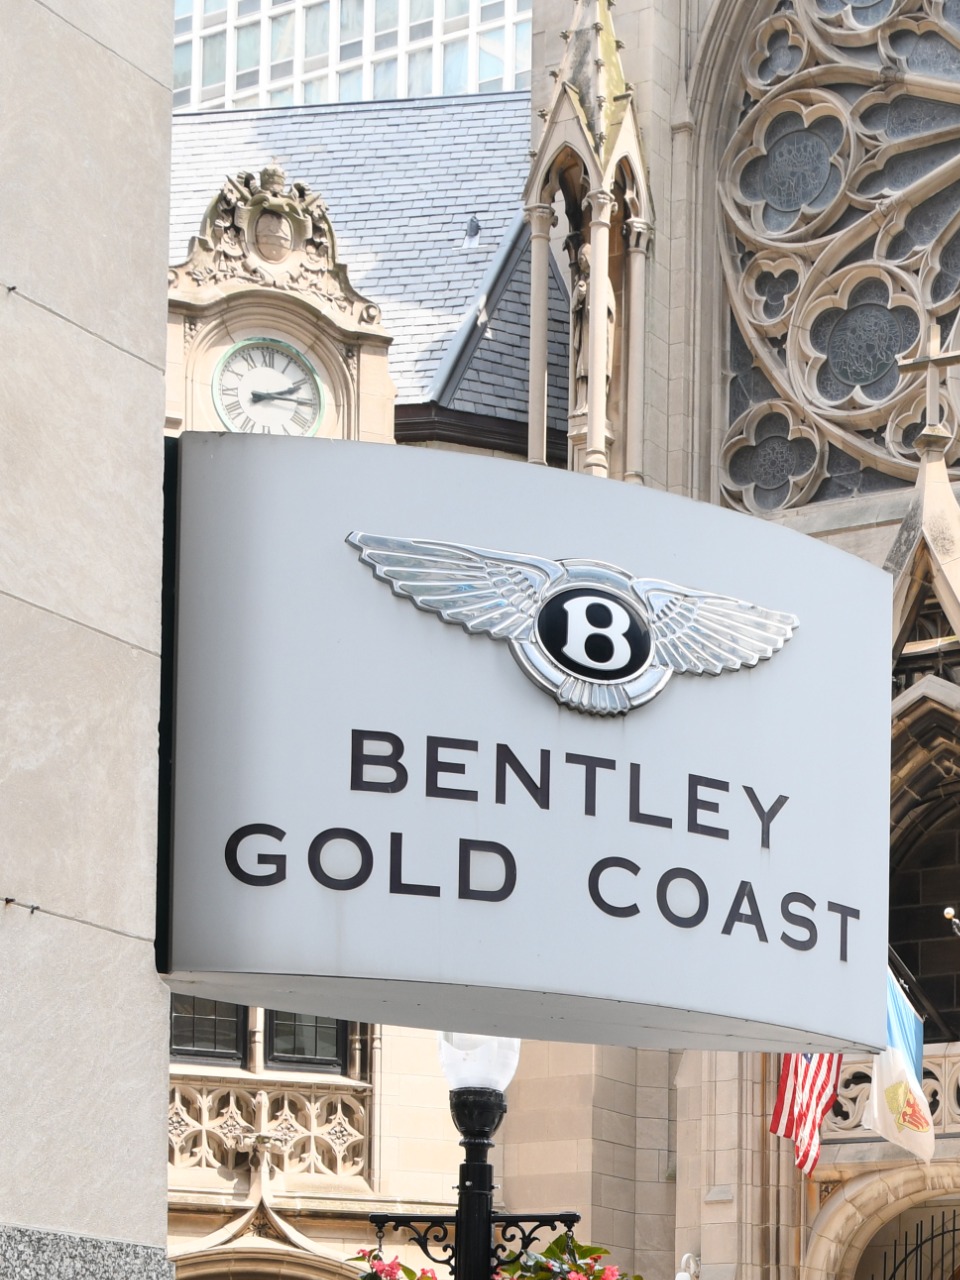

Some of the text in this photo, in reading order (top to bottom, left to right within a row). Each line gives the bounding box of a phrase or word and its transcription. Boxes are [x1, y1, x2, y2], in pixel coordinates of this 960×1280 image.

[561, 595, 633, 672] B
[350, 728, 790, 849] BENTLEY
[223, 823, 861, 963] GOLD COAST
